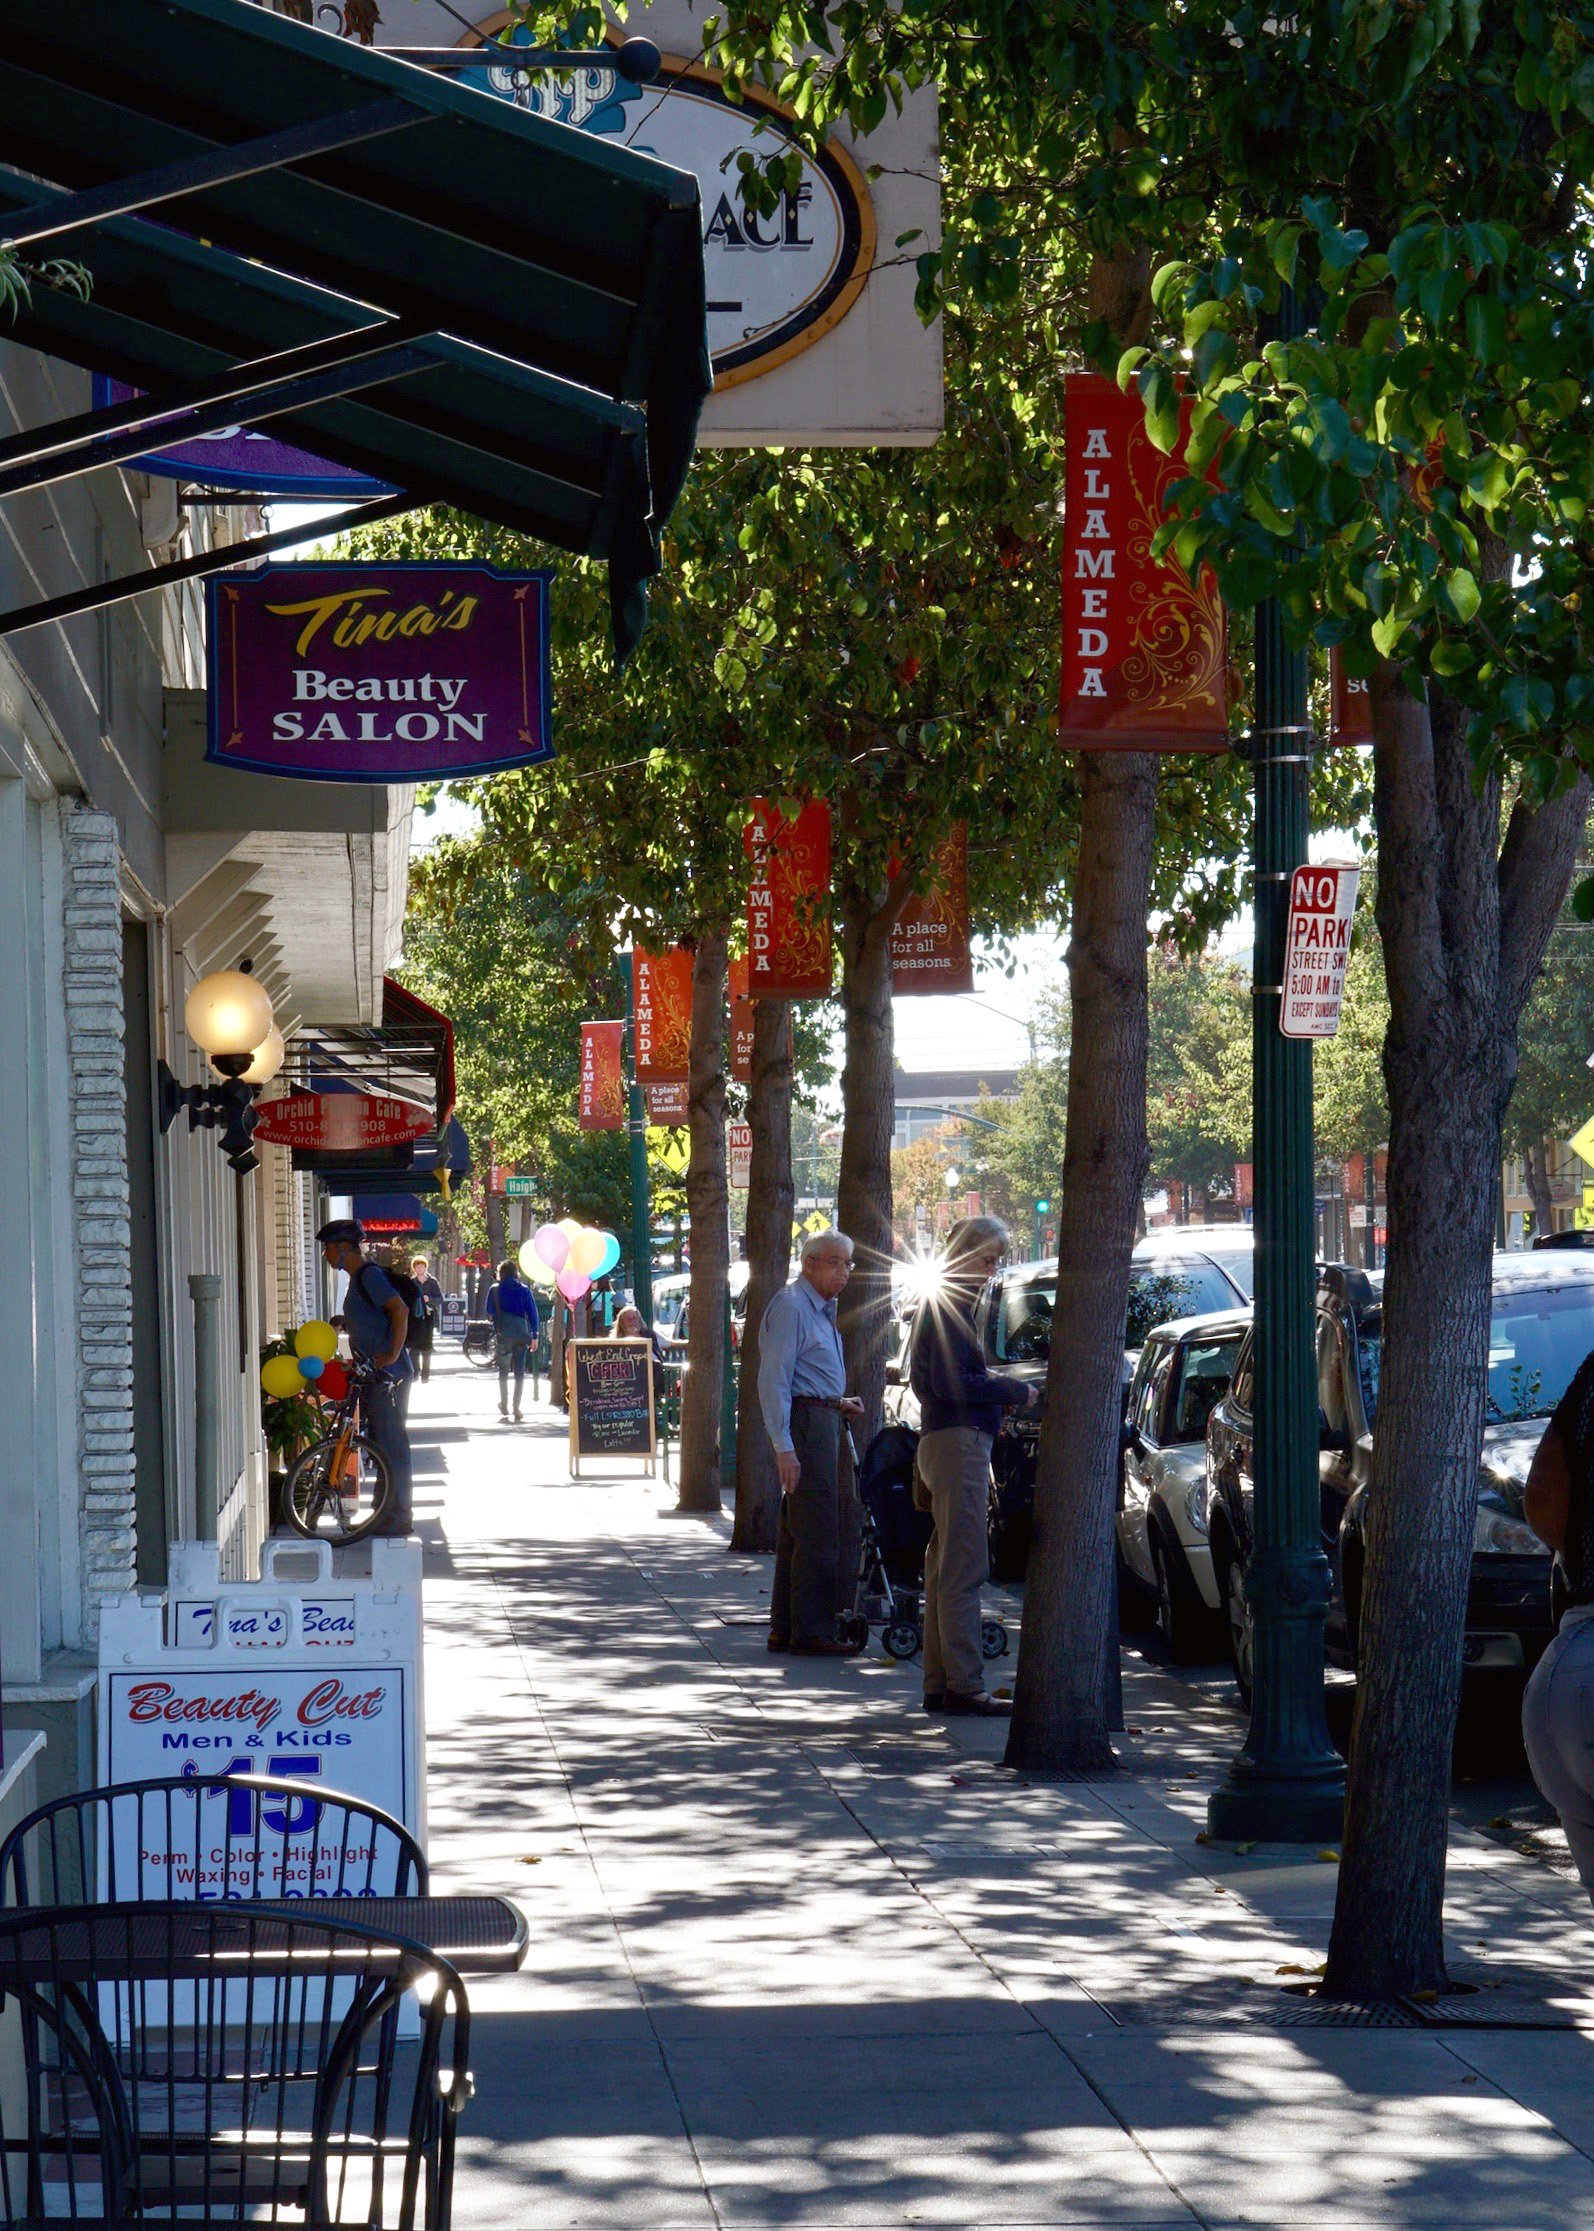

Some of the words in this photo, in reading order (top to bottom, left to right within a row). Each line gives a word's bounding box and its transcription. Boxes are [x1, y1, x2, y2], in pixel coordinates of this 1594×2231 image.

[1075, 429, 1116, 697] ALAMEDA
[264, 588, 478, 658] Tina's
[292, 670, 467, 711] Beauty
[272, 712, 488, 742] SALON
[1295, 875, 1336, 909] NO
[891, 923, 903, 935] A
[906, 922, 947, 938] place
[892, 941, 912, 953] for
[917, 940, 934, 952] all
[892, 957, 951, 969] seasons
[1292, 951, 1330, 970] STREET
[1292, 974, 1313, 995] 5:00
[1316, 975, 1330, 995] AM
[637, 963, 653, 1065] ALAMEDA
[1291, 1001, 1314, 1017] EXCEPT
[582, 1037, 594, 1116] ALAMEDA
[659, 1086, 680, 1096] place
[664, 1096, 674, 1104] all
[276, 1099, 314, 1121] Orchid
[376, 1100, 401, 1120] Cafe
[289, 1120, 386, 1132] 510-8908
[263, 1128, 416, 1145] www.orchidoncafe.com
[590, 1361, 631, 1379] OPEN
[192, 1607, 282, 1635] Tna's
[127, 1681, 282, 1731] Beauty
[297, 1678, 385, 1727] Cut
[162, 1732, 233, 1749] Men
[245, 1733, 265, 1747] &
[276, 1730, 352, 1747] Kids
[140, 1850, 188, 1865] Perm
[210, 1847, 265, 1864] Color
[286, 1845, 378, 1865] Highlght
[176, 1867, 250, 1885] Waxing
[273, 1865, 331, 1881] Facal
